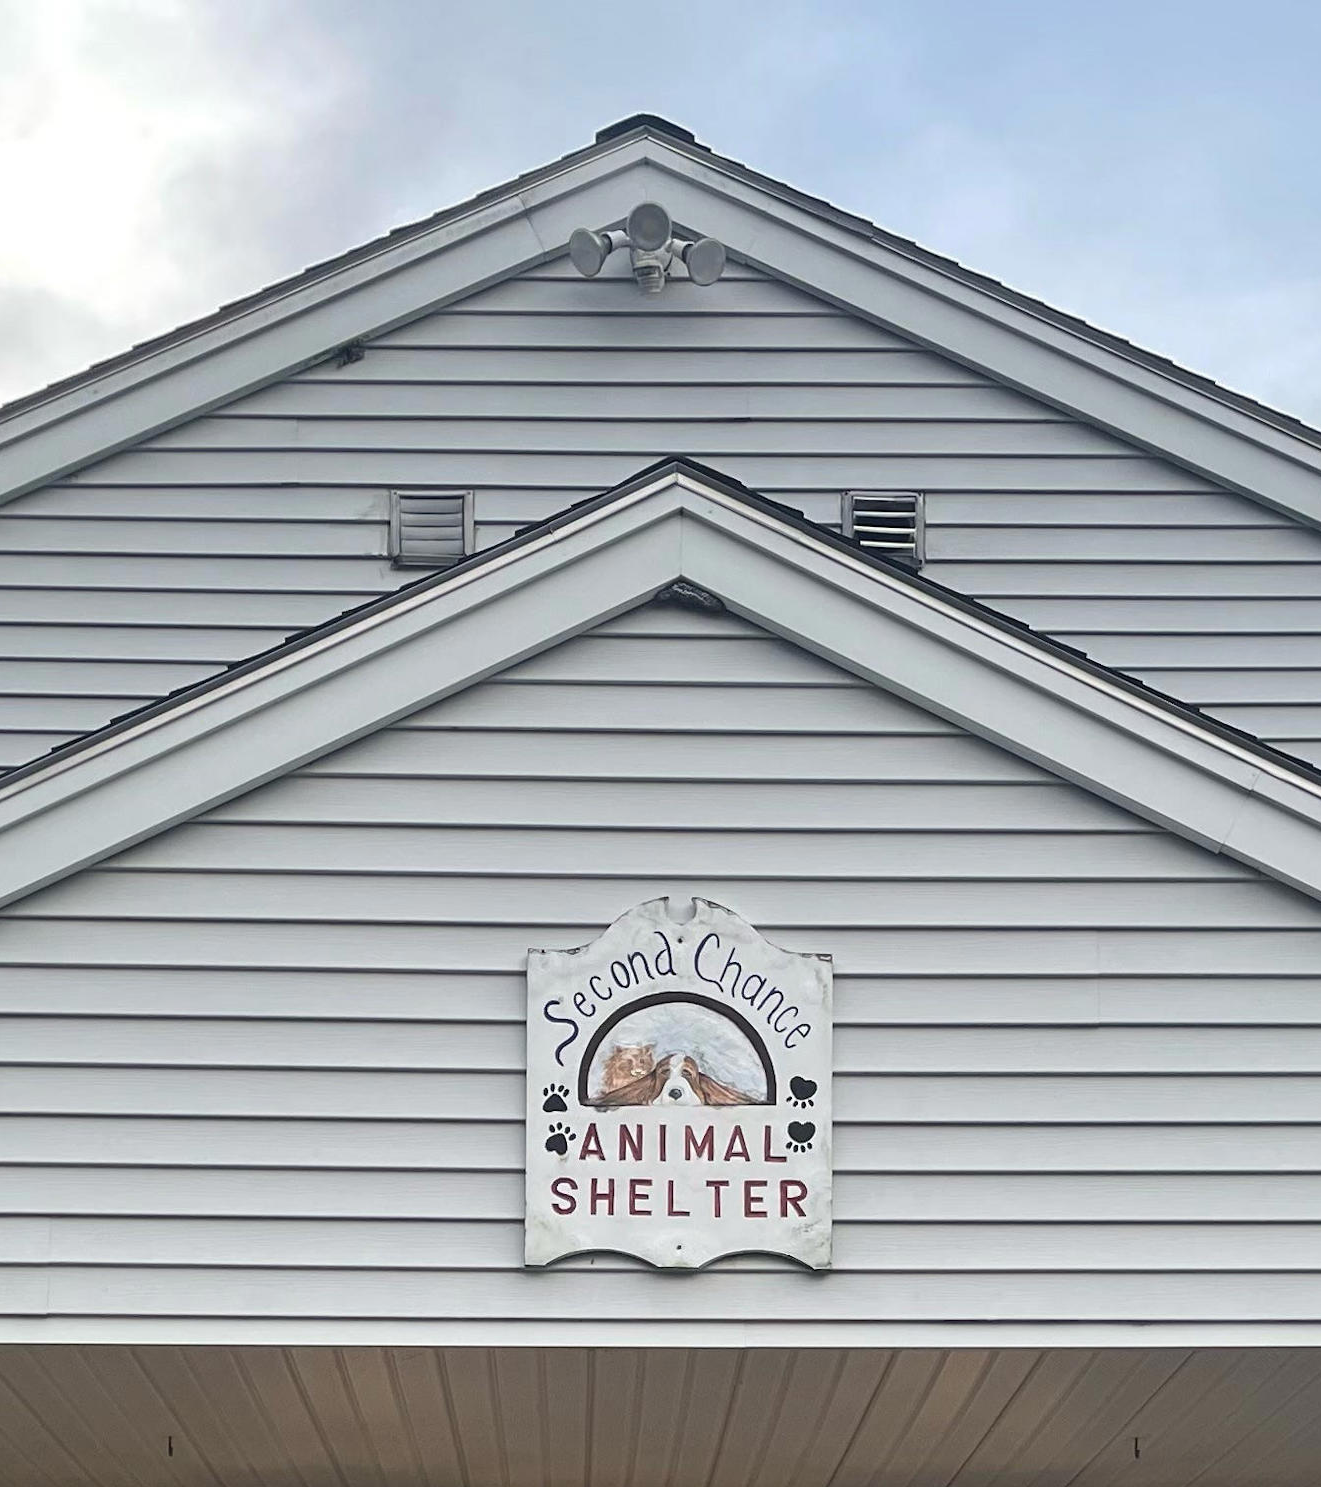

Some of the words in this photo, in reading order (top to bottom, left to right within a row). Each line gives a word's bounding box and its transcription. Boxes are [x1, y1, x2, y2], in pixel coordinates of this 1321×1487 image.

[543, 931, 677, 1067] Second
[694, 933, 811, 1049] Chance
[579, 1122, 788, 1163] ANIMAL
[551, 1177, 809, 1219] SHELTER
